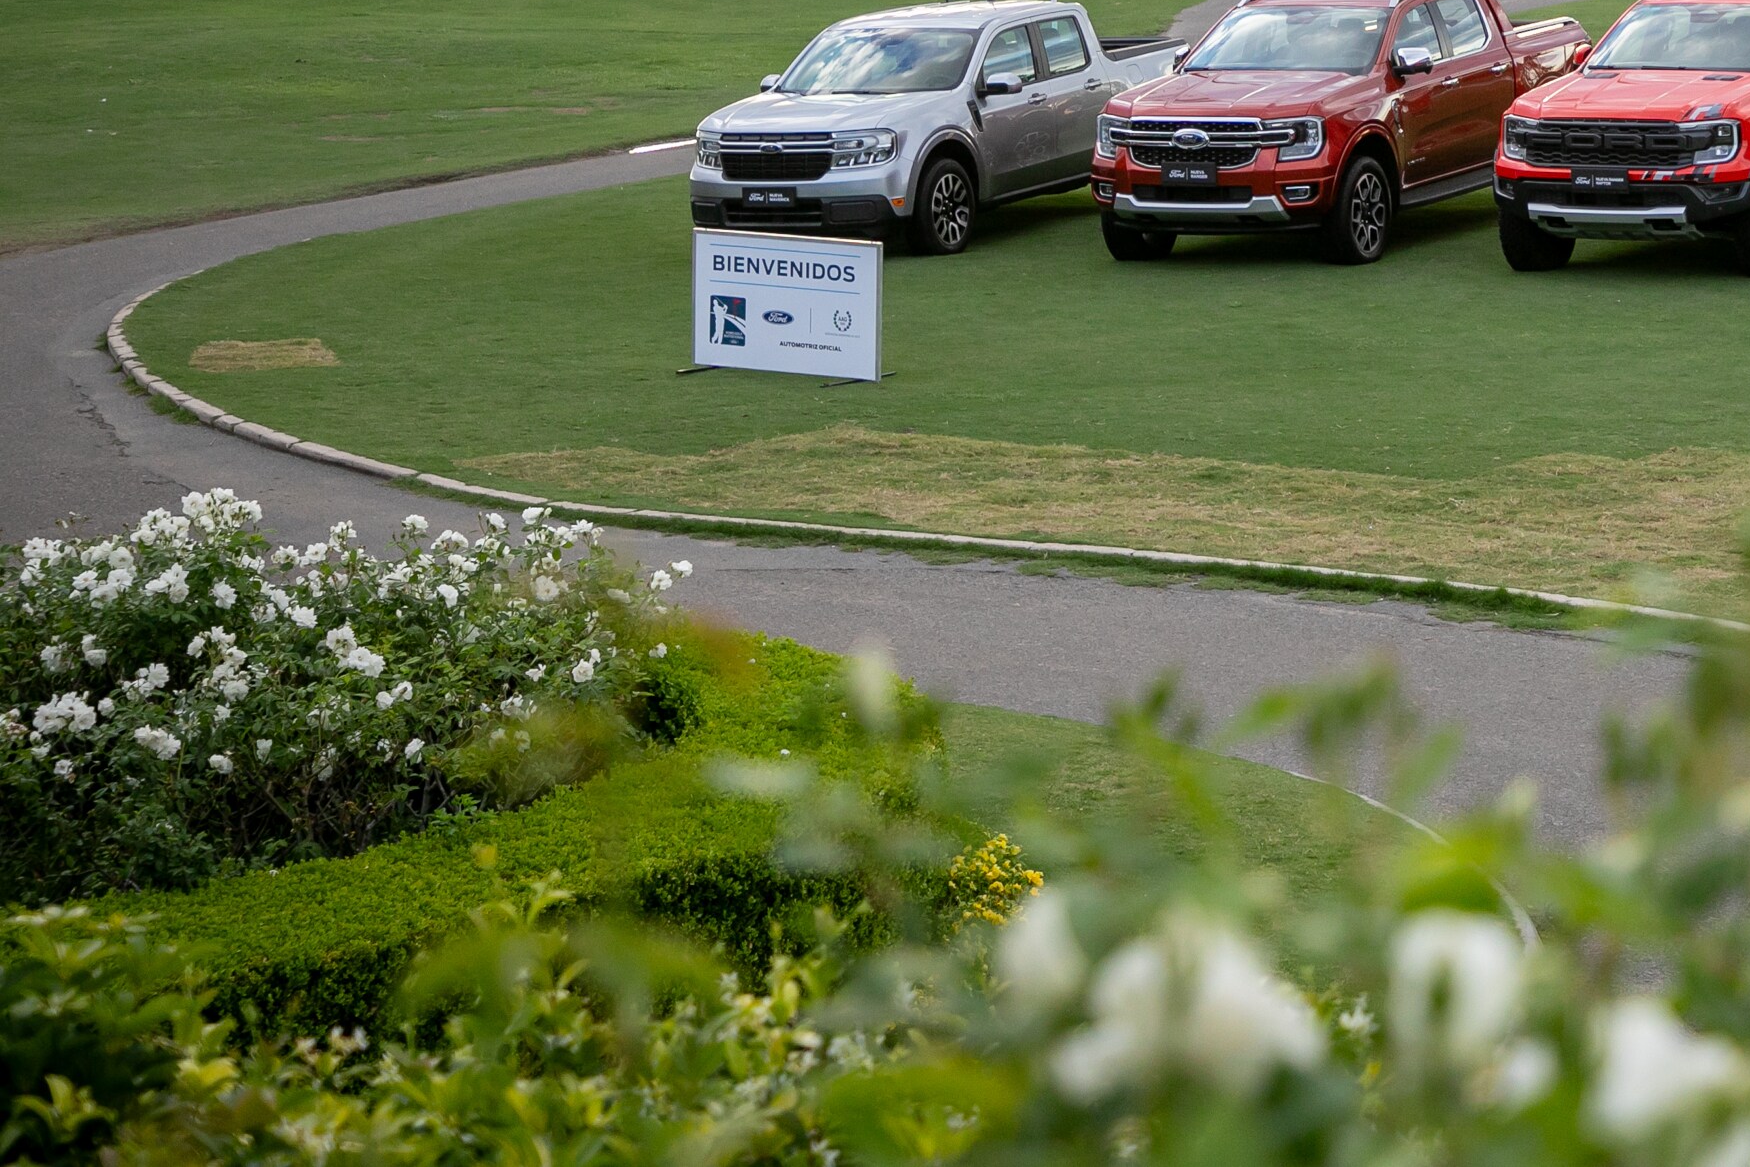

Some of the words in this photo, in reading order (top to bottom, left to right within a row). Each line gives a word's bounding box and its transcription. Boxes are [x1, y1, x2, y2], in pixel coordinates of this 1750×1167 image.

[1525, 132, 1689, 150] FORD
[1169, 170, 1186, 178] Ford
[1575, 177, 1591, 185] Ford
[749, 193, 765, 201] Ford
[713, 254, 856, 283] BIENVENIDOS
[766, 312, 790, 324] Ford
[779, 341, 818, 350] AUTOMOTRIZ
[818, 344, 842, 352] OFICIAL
